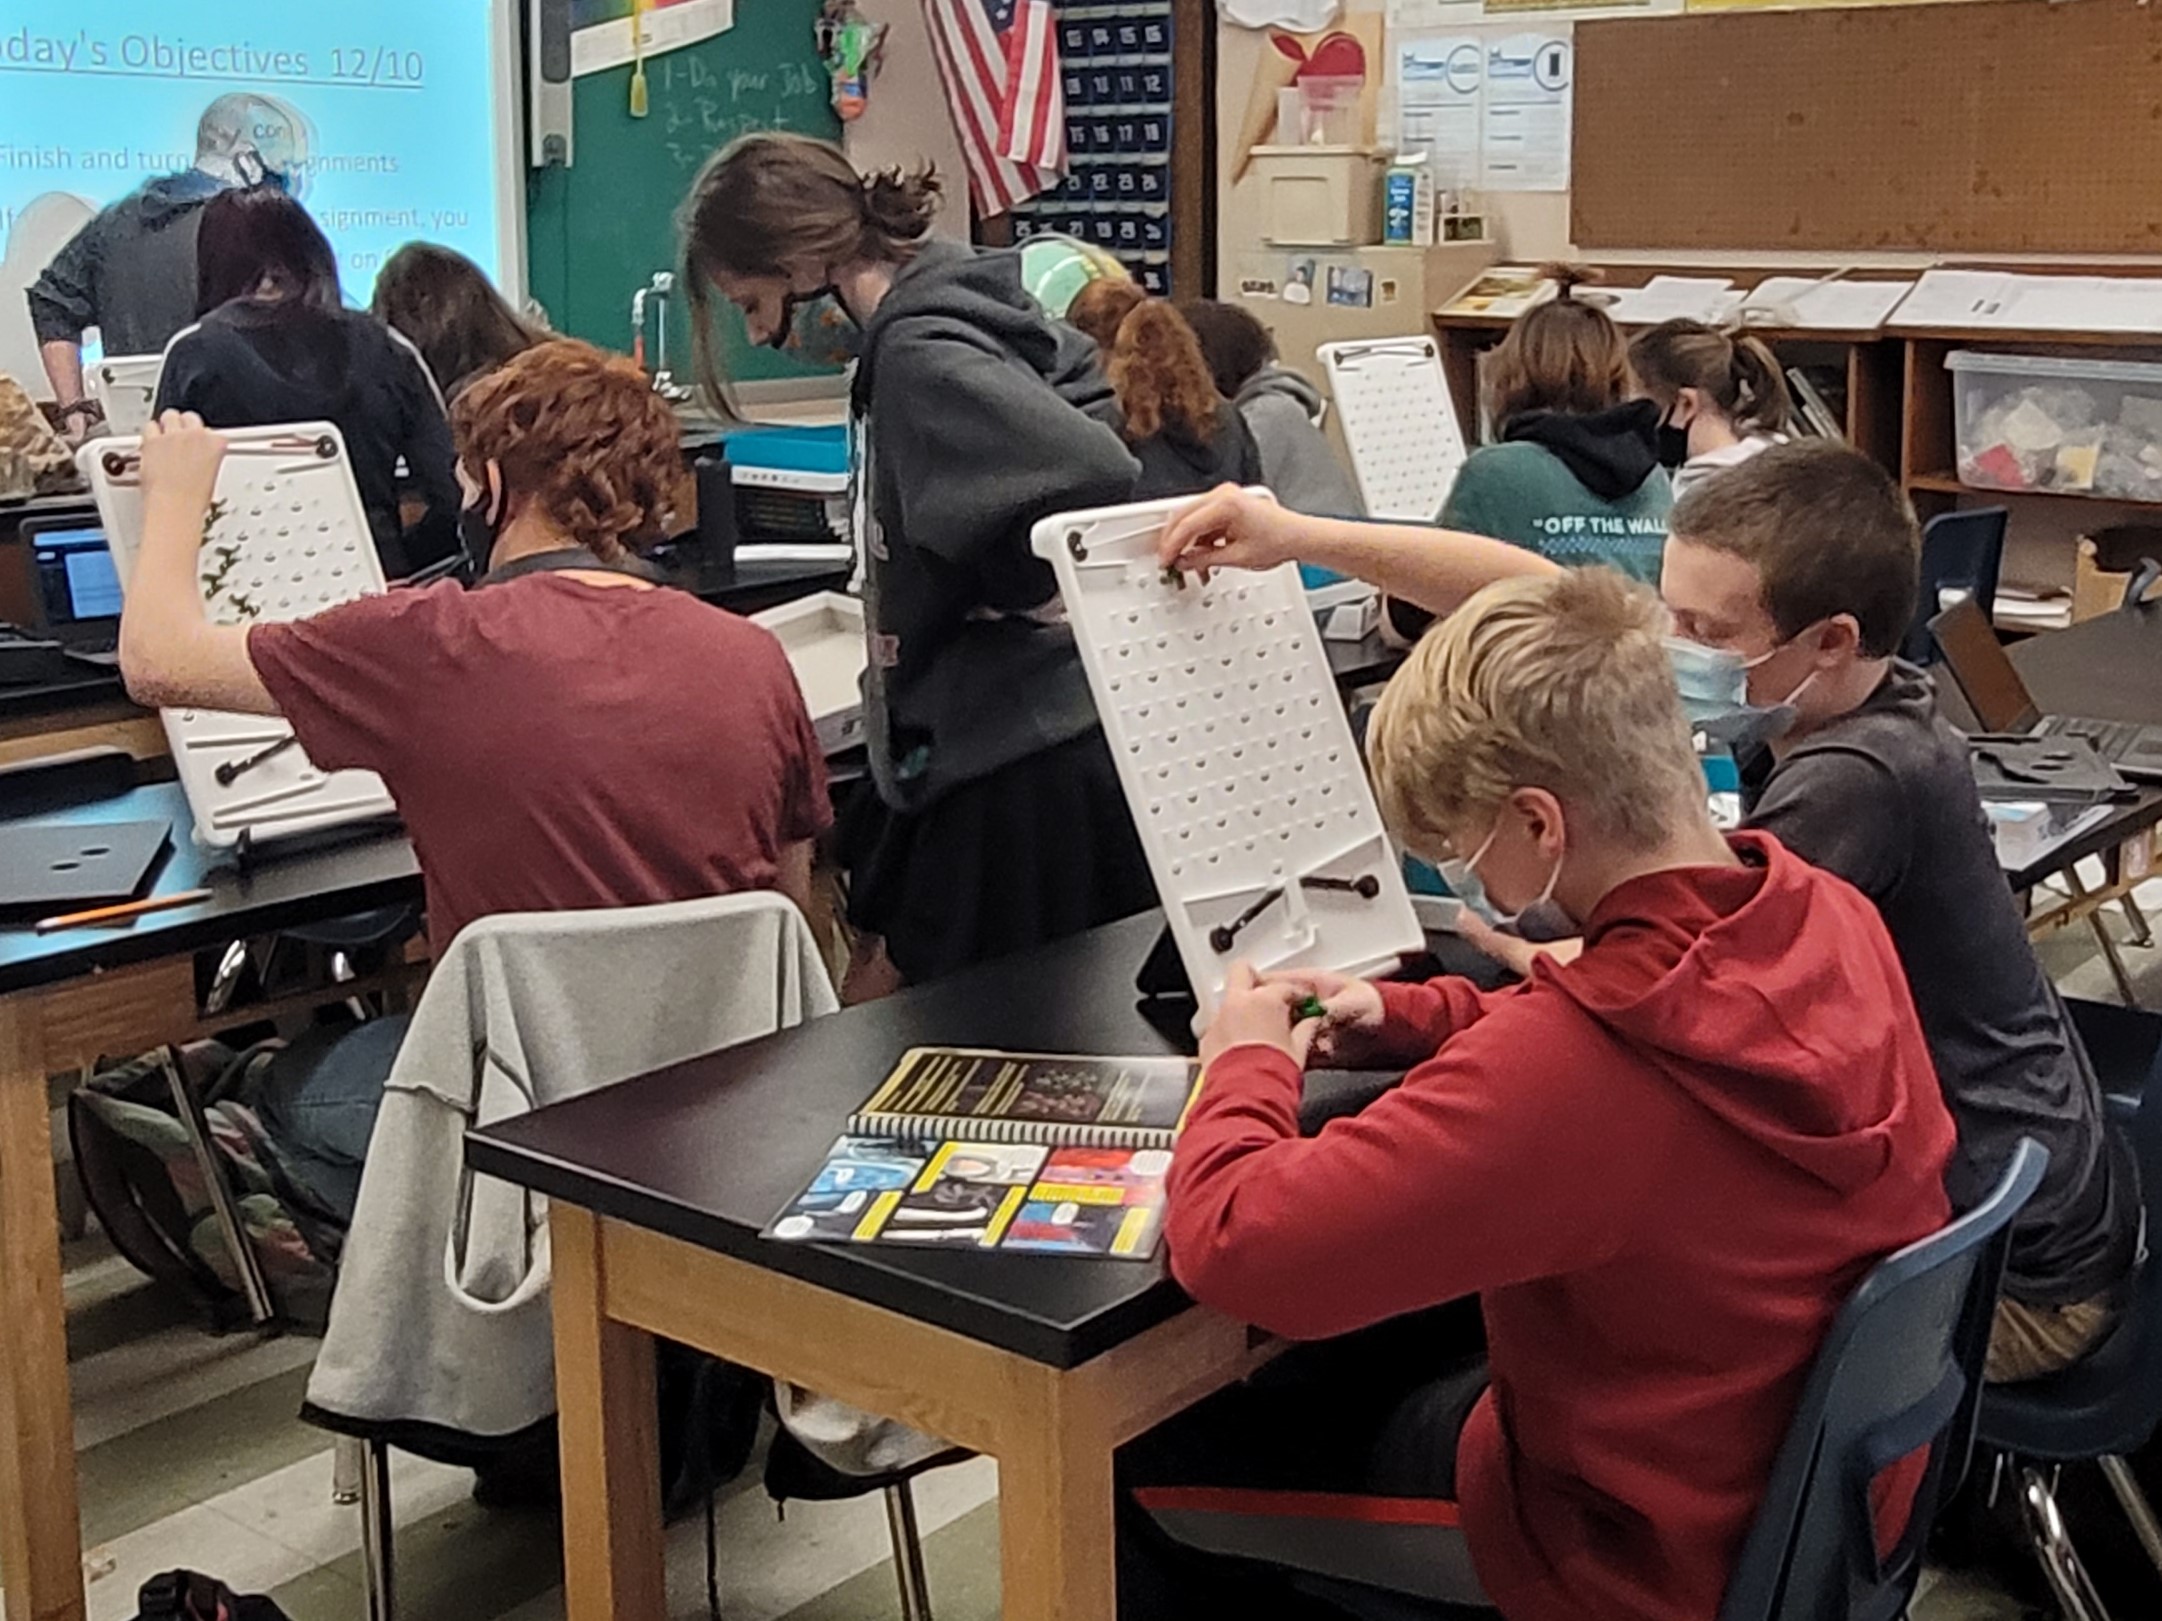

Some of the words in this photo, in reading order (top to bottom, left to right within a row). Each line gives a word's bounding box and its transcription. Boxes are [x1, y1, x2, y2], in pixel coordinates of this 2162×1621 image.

[0, 26, 107, 71] day's
[121, 35, 308, 77] Objectives
[331, 45, 423, 86] 12/10
[1143, 74, 1162, 92] 12
[81, 147, 129, 171] and
[138, 151, 190, 171] turn
[306, 154, 399, 177] gnments
[320, 205, 426, 232] signment,
[431, 210, 469, 231] you
[350, 252, 378, 270] on
[1532, 515, 1585, 534] "OFF
[1589, 517, 1624, 535] THE
